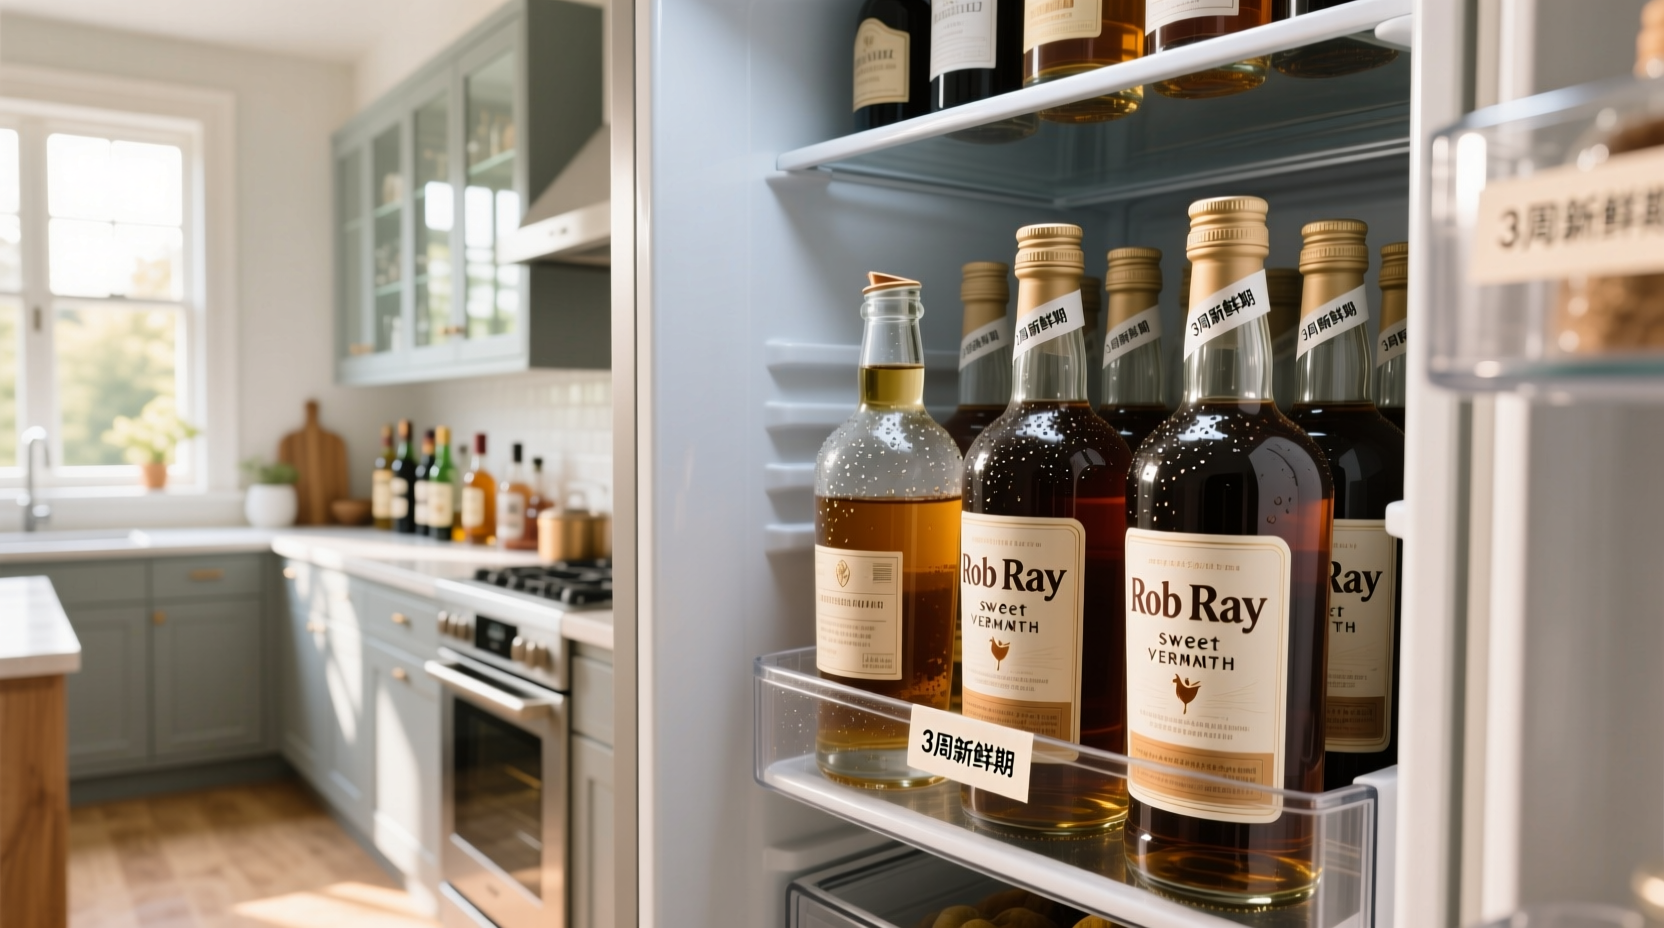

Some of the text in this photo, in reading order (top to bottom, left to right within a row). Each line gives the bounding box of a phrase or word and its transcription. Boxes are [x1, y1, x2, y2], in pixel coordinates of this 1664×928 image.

[962, 553, 1067, 602] Rob Ray
[1131, 577, 1268, 634] Rob Ray
[922, 729, 1014, 778] 3周新鲜期
